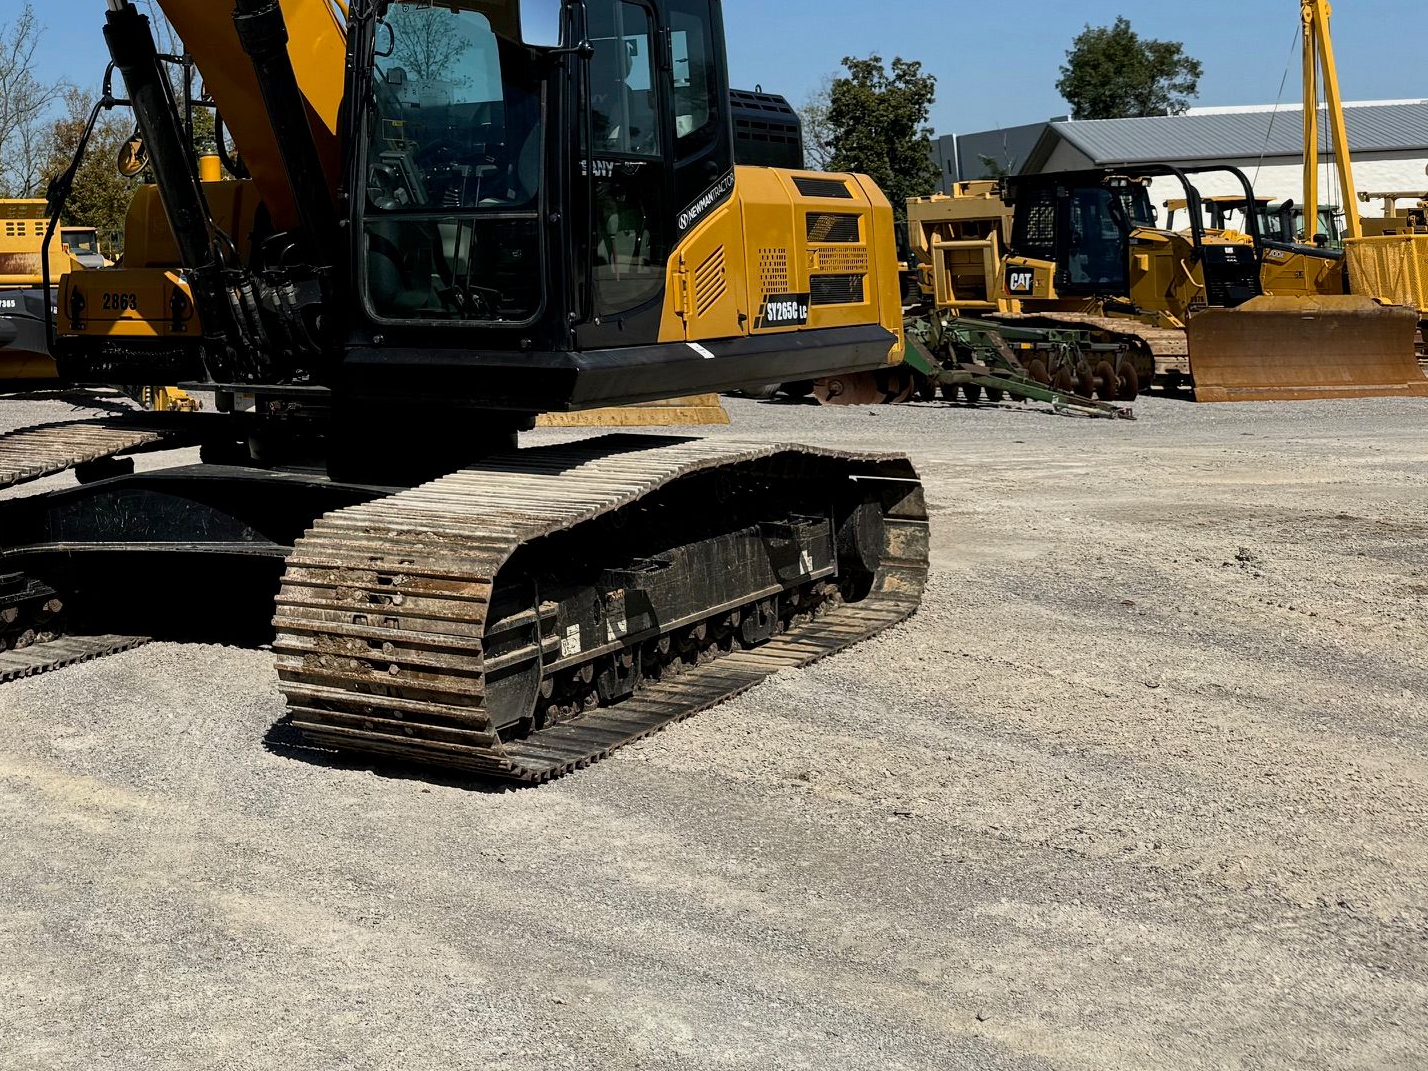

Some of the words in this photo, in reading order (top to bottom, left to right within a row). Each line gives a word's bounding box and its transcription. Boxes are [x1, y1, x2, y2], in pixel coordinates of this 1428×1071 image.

[1010, 273, 1032, 291] CAT
[103, 293, 137, 310] 2863
[767, 301, 798, 321] SY265C
[799, 305, 808, 319] LC
